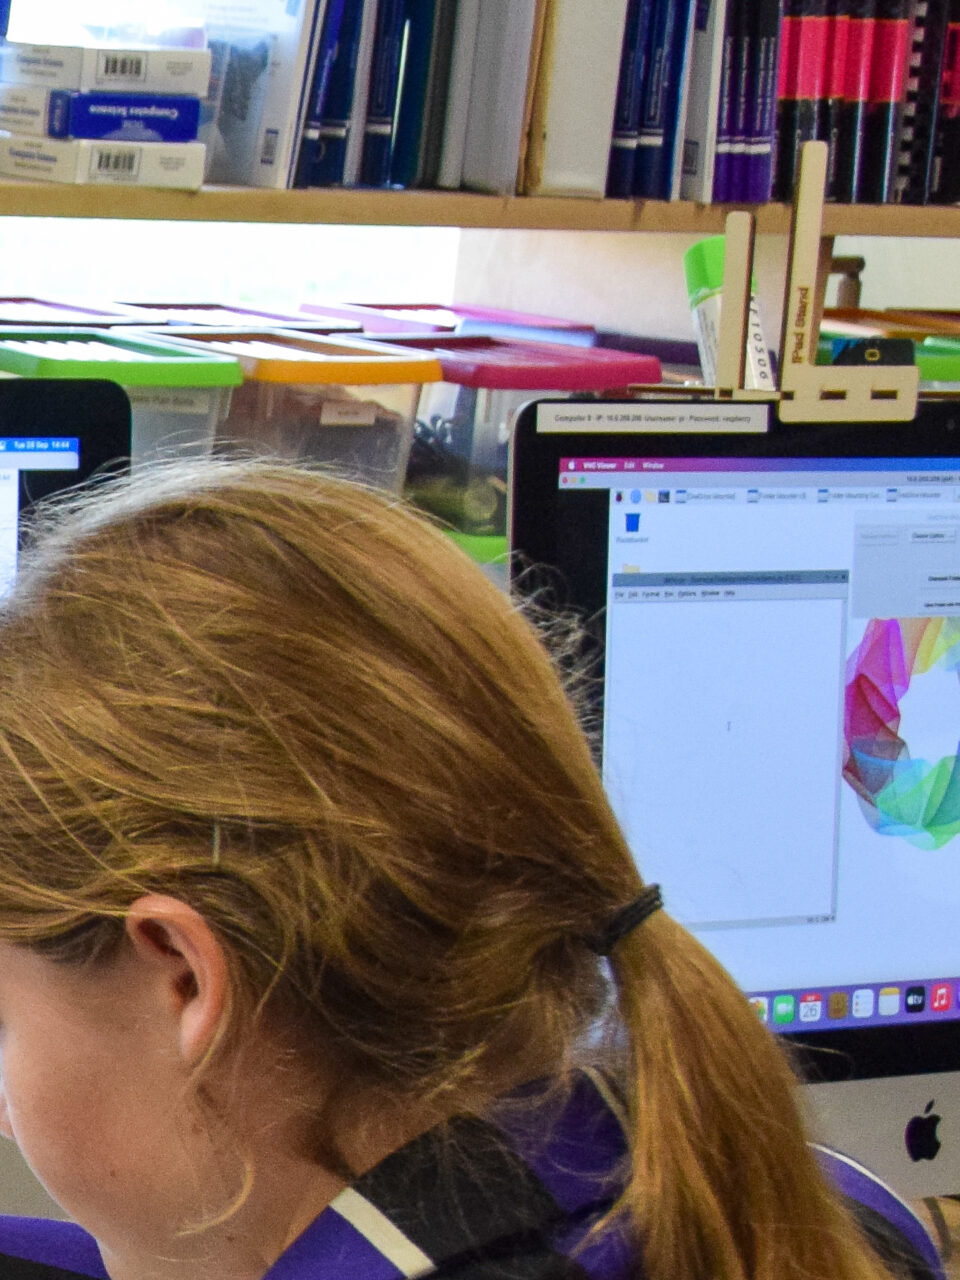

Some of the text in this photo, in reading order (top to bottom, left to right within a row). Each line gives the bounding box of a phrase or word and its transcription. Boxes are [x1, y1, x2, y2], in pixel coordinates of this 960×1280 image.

[129, 105, 179, 120] Computer
[795, 287, 809, 328] Stand
[802, 1004, 818, 1018] 26
